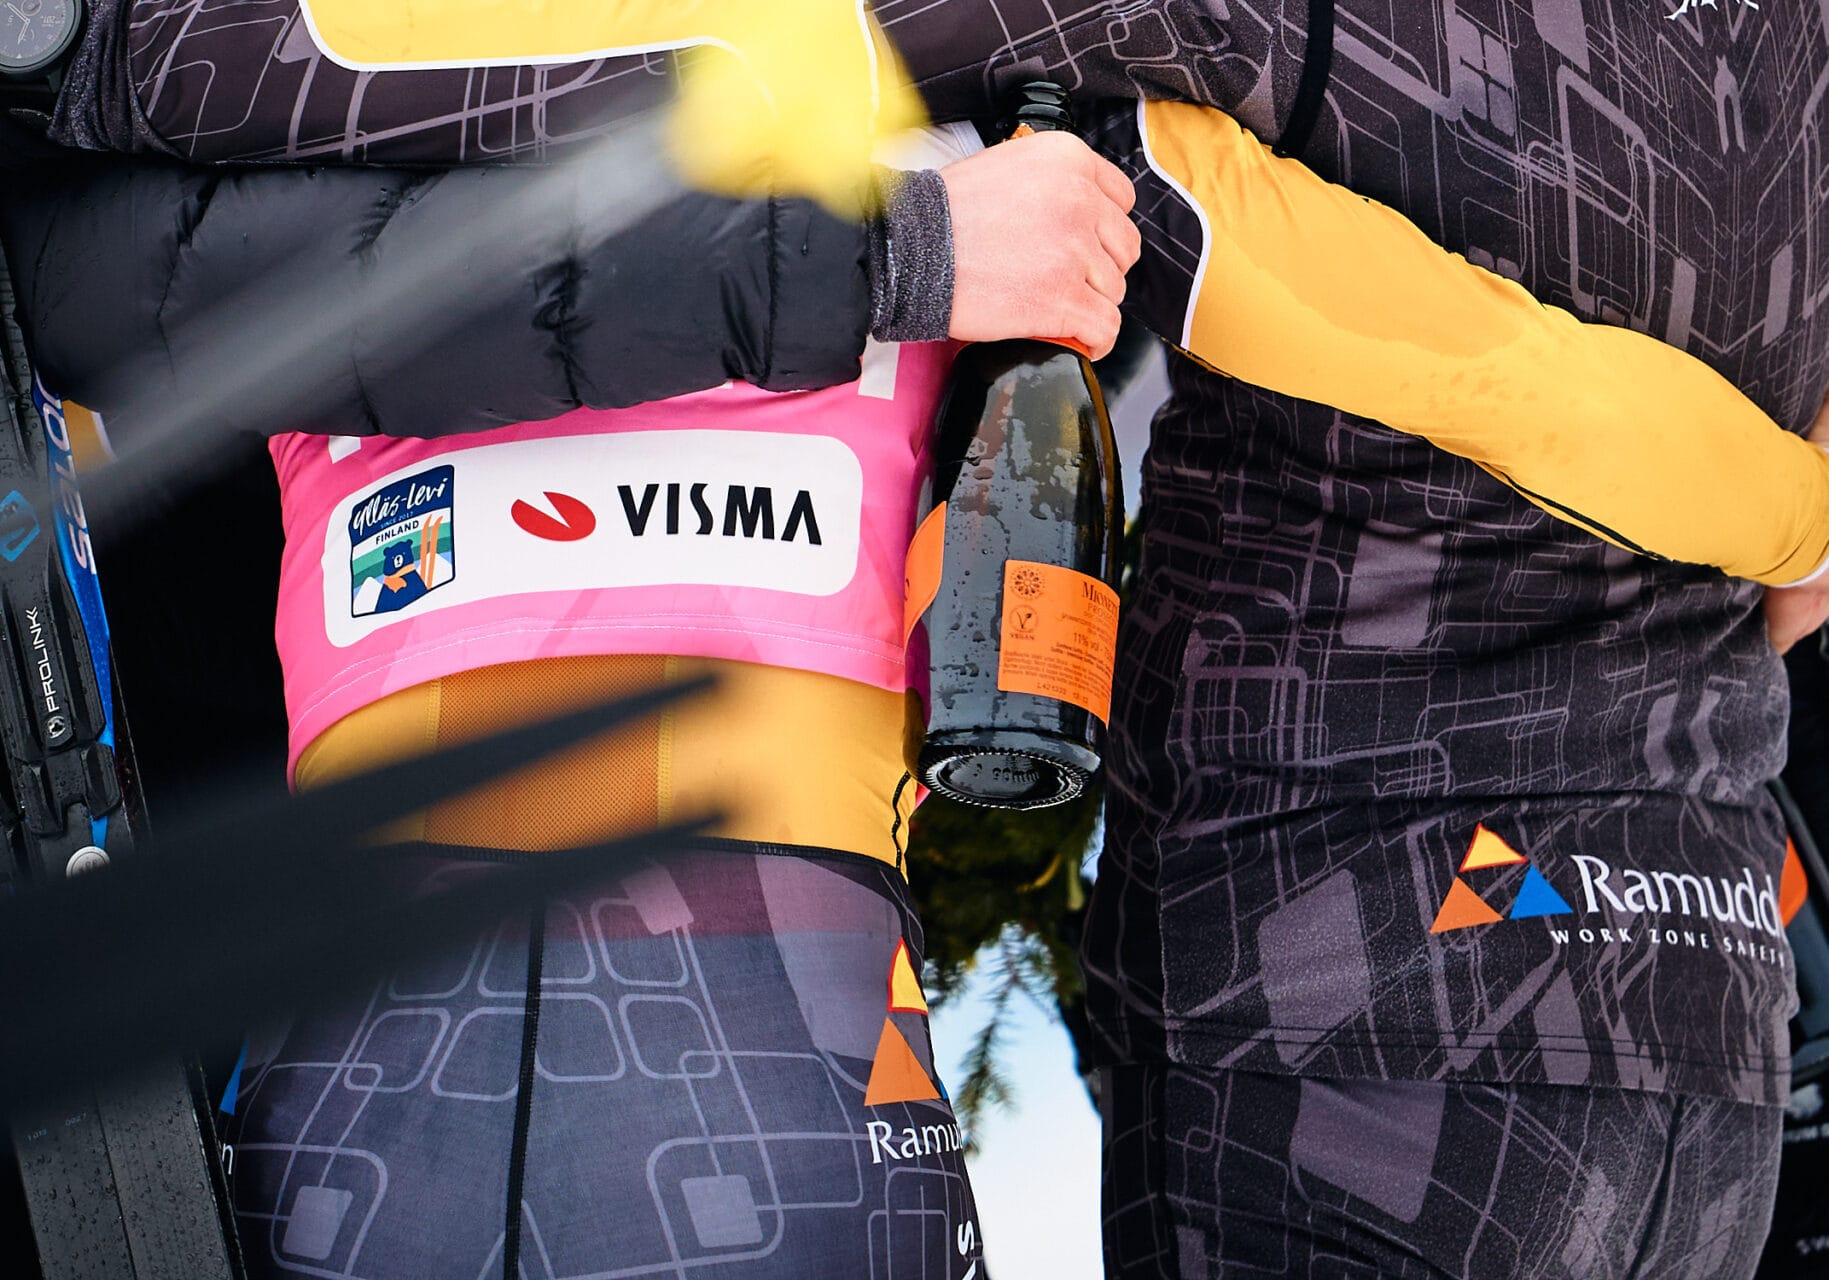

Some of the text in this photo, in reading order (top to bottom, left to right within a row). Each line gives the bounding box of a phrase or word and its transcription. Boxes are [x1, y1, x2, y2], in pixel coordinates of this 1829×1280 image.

[375, 520, 419, 545] FINLAND
[617, 483, 822, 545] VISMA
[26, 606, 59, 713] PROLINK
[1571, 854, 1784, 939] Ramudd
[1550, 929, 1632, 946] WORK
[1651, 929, 1709, 950] ZONE
[865, 1120, 963, 1165] Ramu
